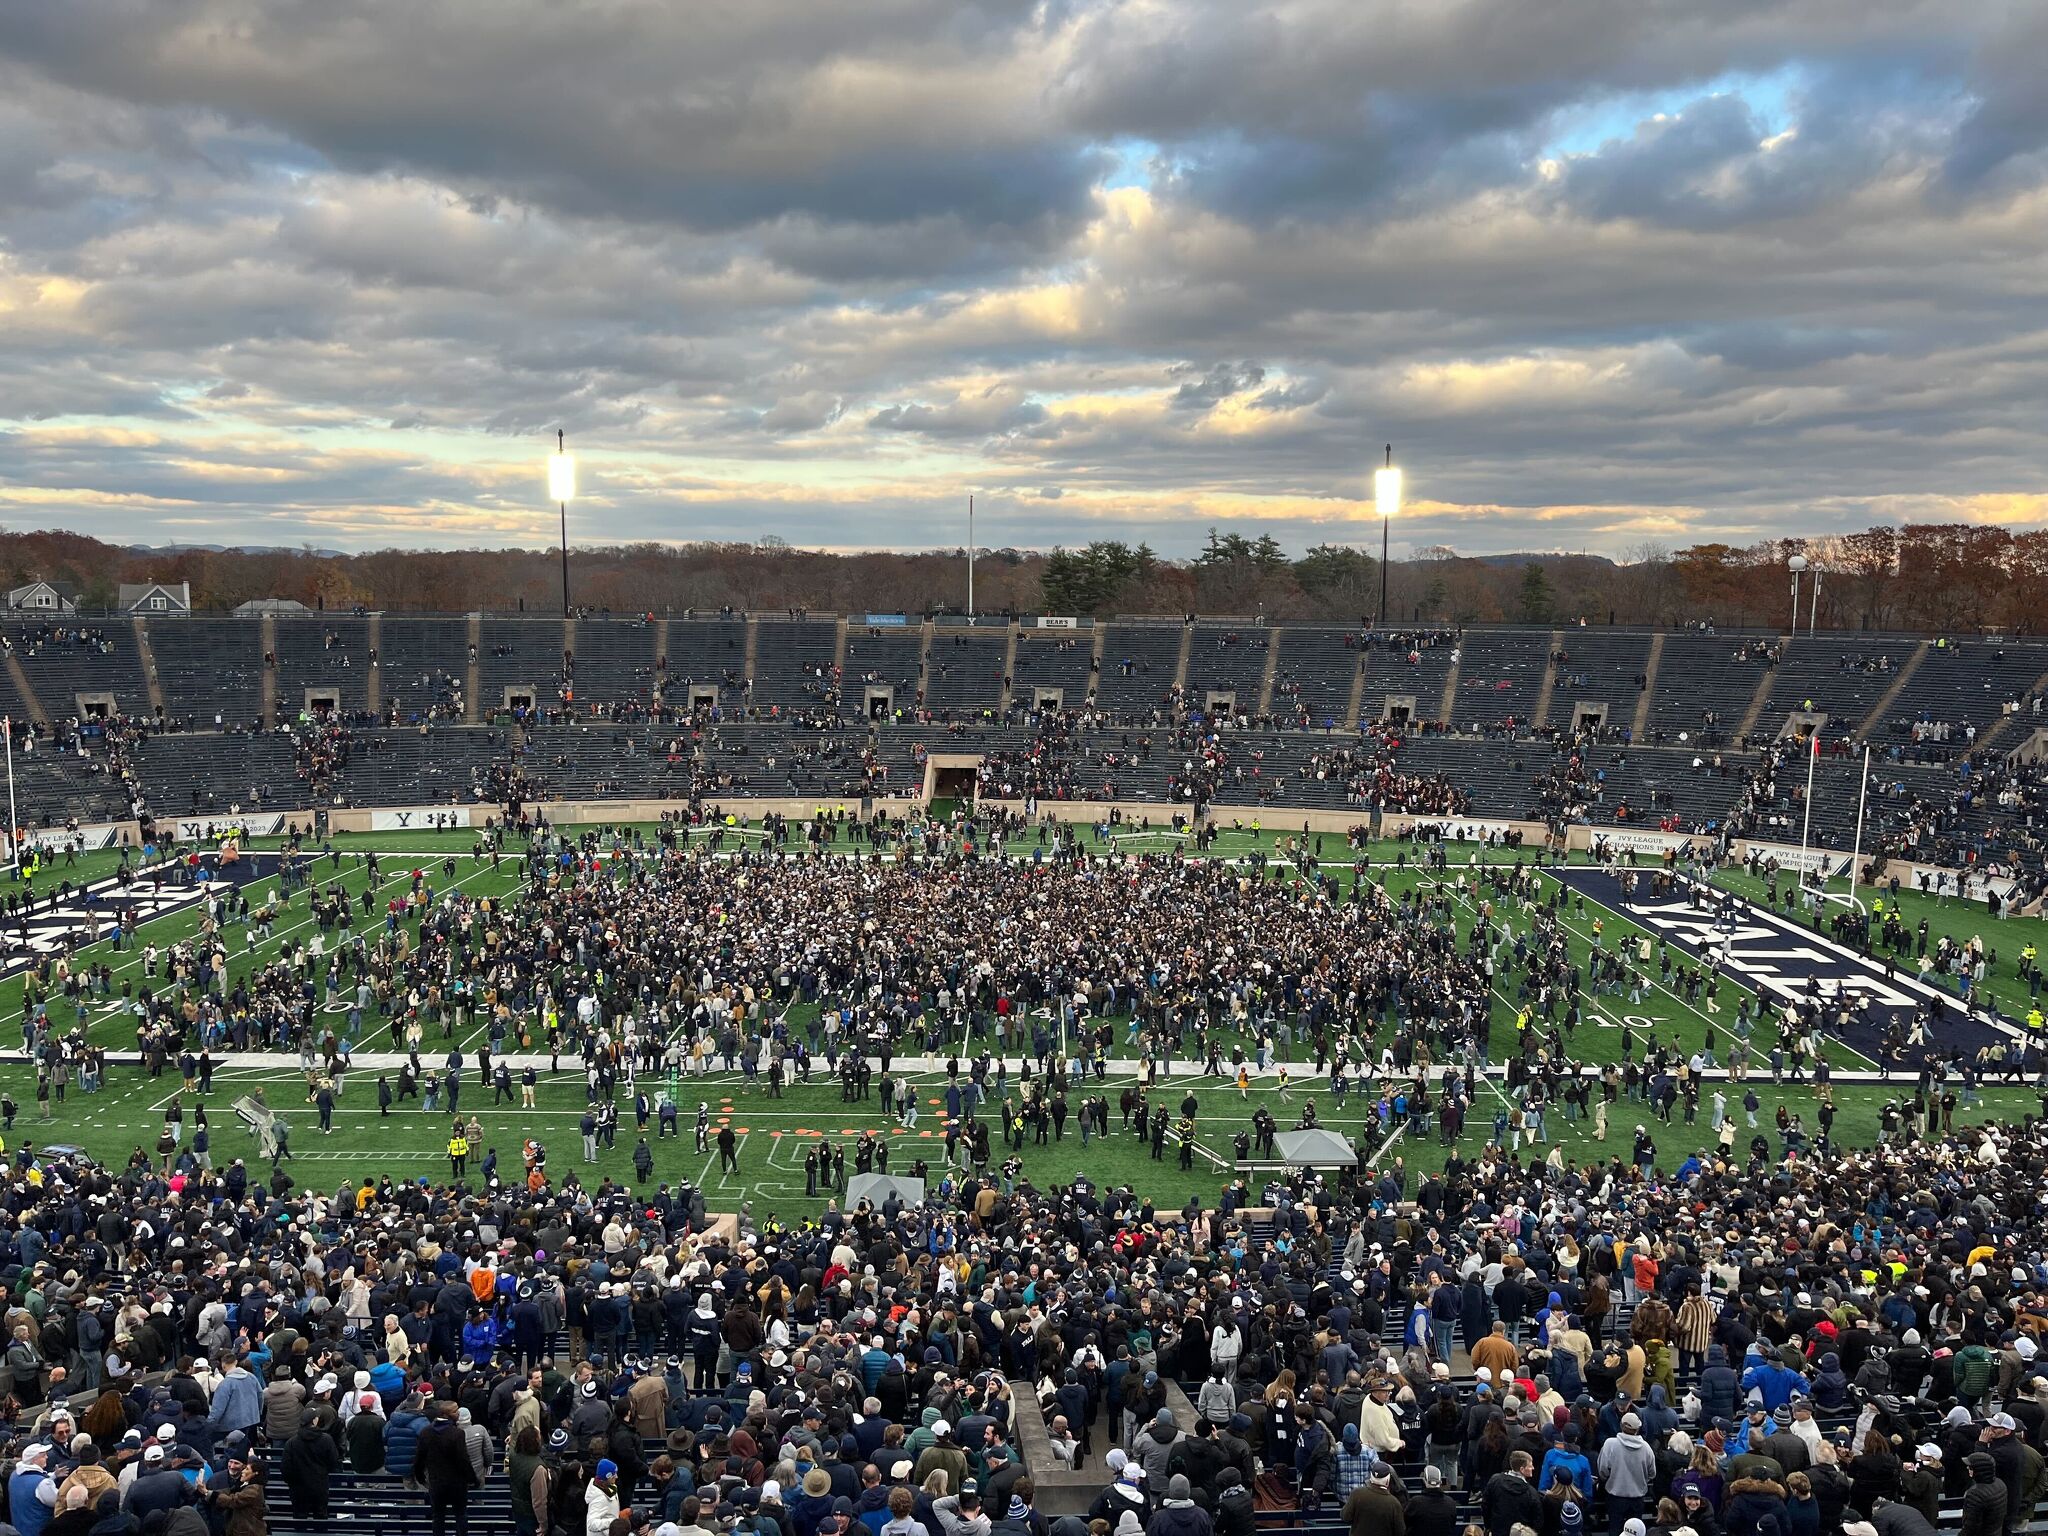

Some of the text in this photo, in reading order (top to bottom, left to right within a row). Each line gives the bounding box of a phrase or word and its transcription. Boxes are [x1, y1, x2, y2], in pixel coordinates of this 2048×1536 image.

[967, 617, 977, 627] Y
[224, 819, 256, 827] LEAUE
[396, 812, 412, 827] Y
[181, 823, 197, 837] Y
[1438, 822, 1453, 837] Y
[1634, 836, 1664, 844] LEAGUE
[1775, 850, 1790, 858] IVY
[1619, 901, 1924, 1006] YALE
[1585, 1014, 1655, 1028] 10
[1838, 1439, 1846, 1447] Y
